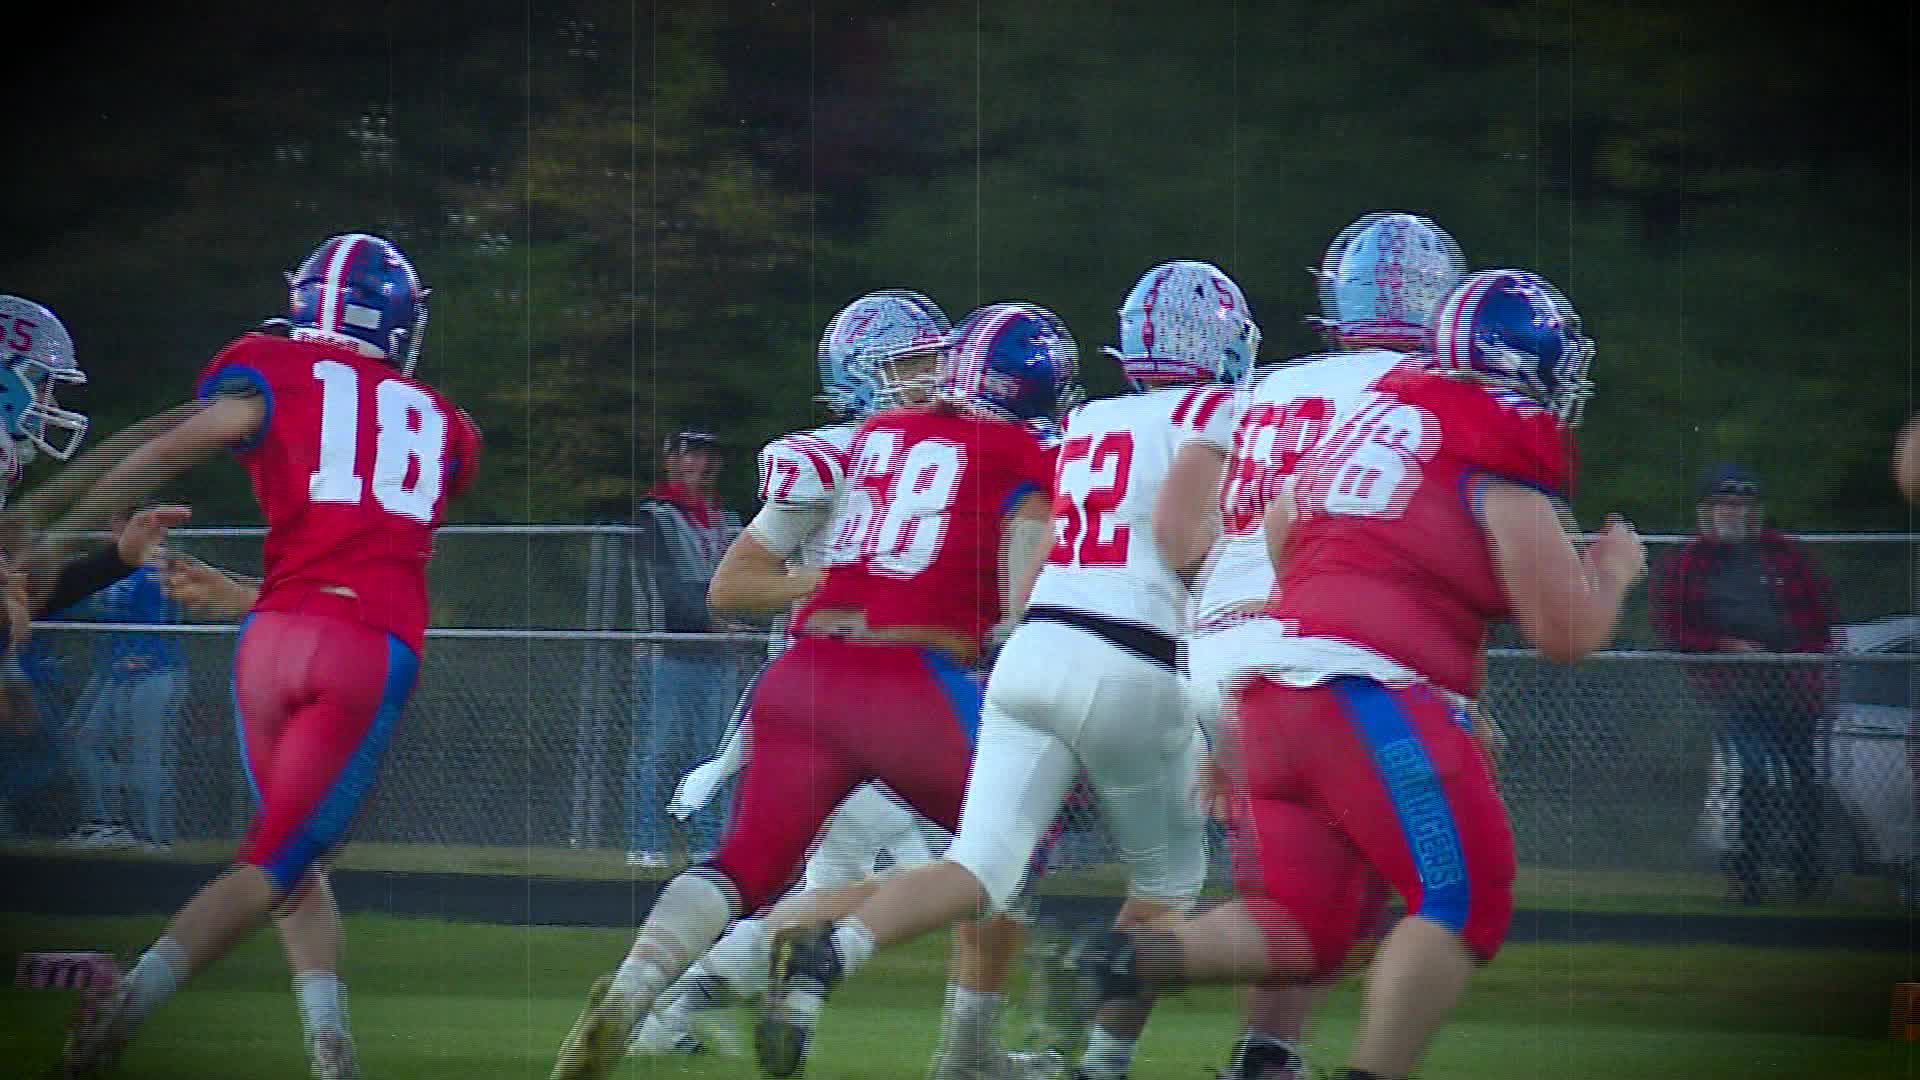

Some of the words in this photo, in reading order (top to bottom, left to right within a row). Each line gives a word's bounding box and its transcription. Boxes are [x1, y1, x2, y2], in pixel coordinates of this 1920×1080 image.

[308, 359, 447, 524] 18
[762, 453, 798, 501] 17
[832, 427, 968, 580] 68
[1048, 431, 1134, 568] 52
